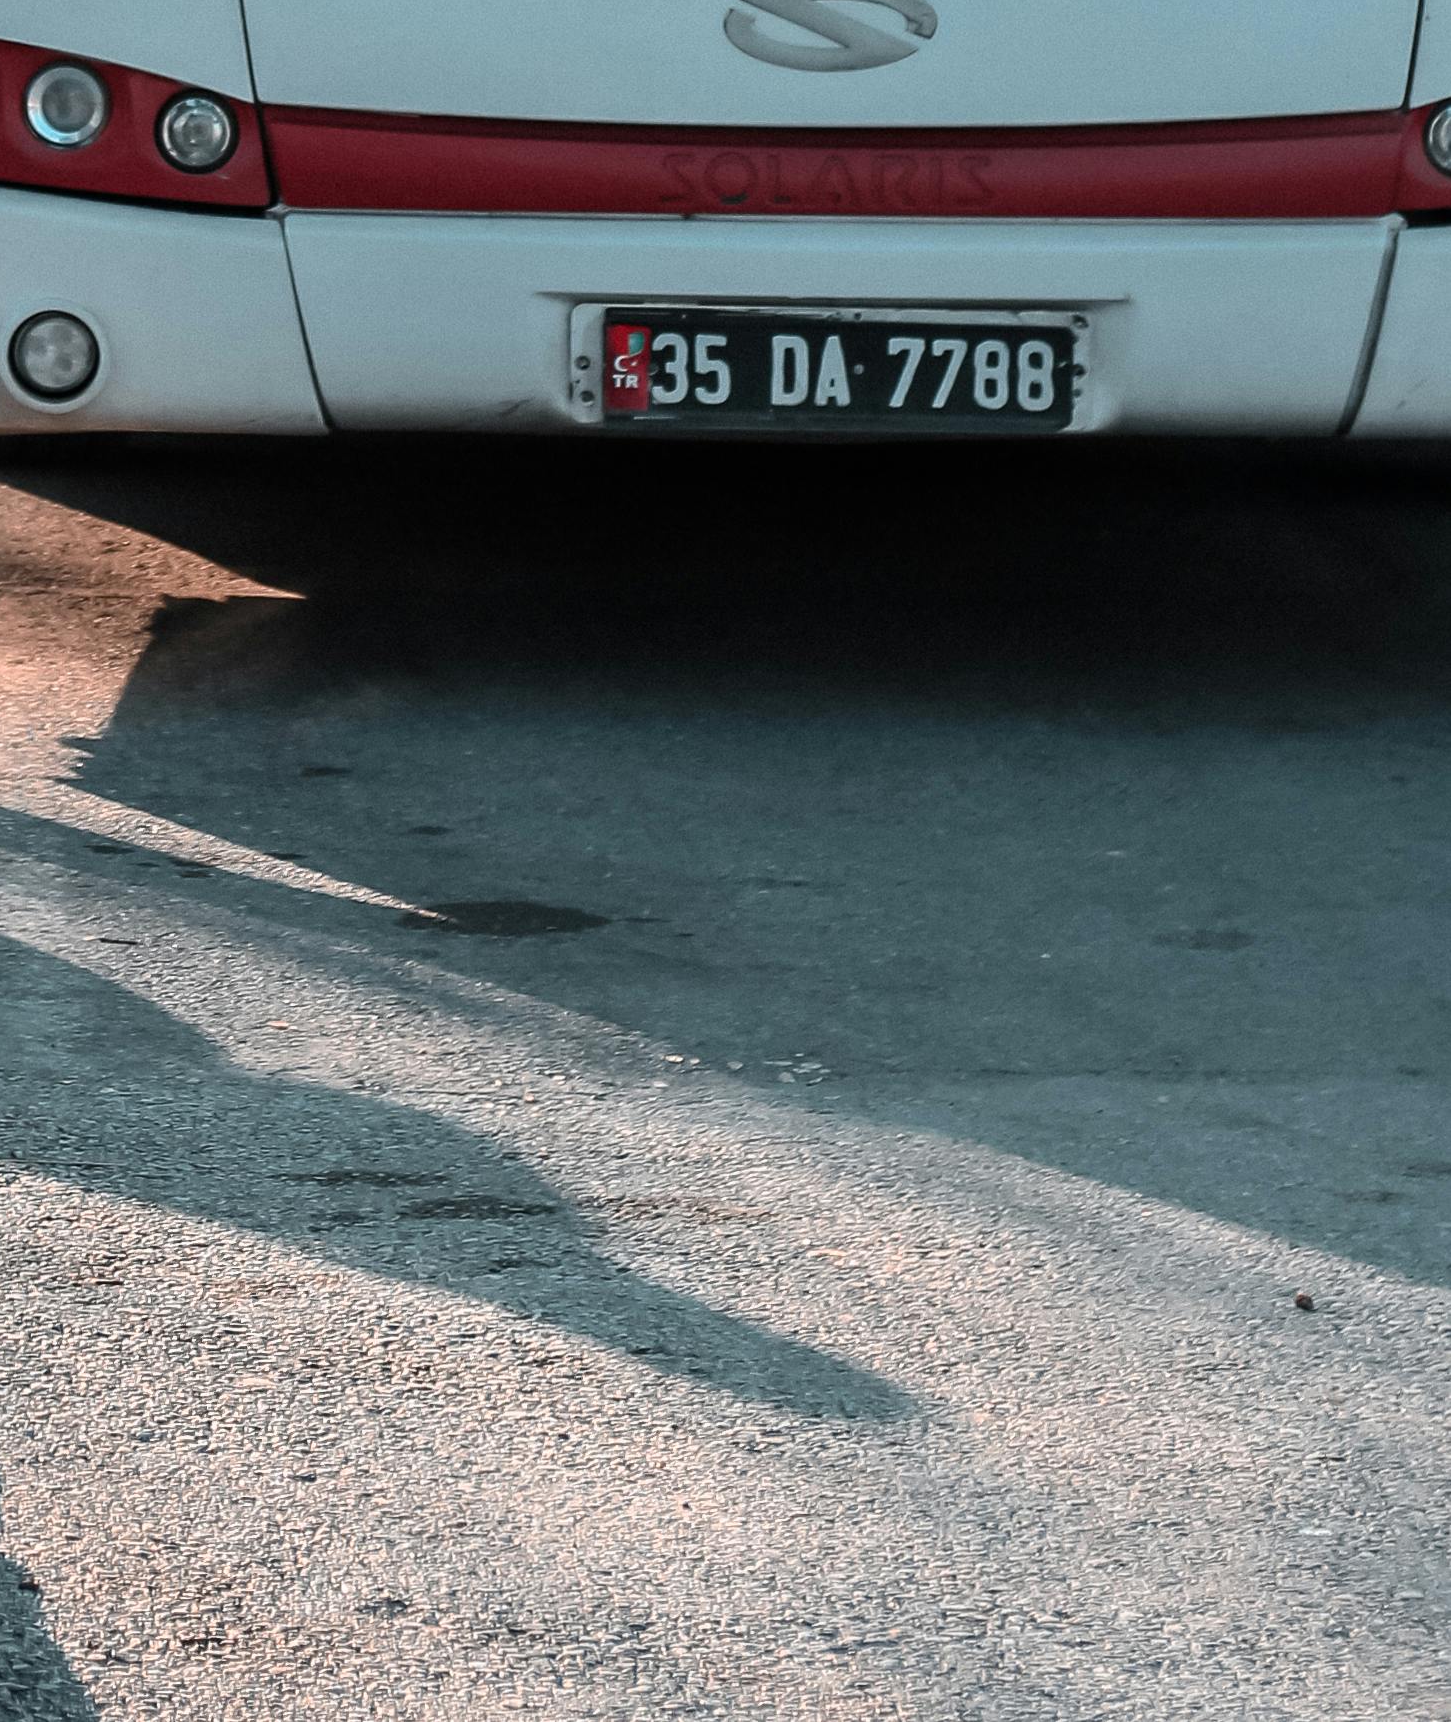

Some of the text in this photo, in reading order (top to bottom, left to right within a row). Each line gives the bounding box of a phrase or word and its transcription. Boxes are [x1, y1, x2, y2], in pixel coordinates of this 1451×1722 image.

[660, 151, 995, 207] SOLARIS
[612, 332, 1054, 412] TR 35 DA 7788
